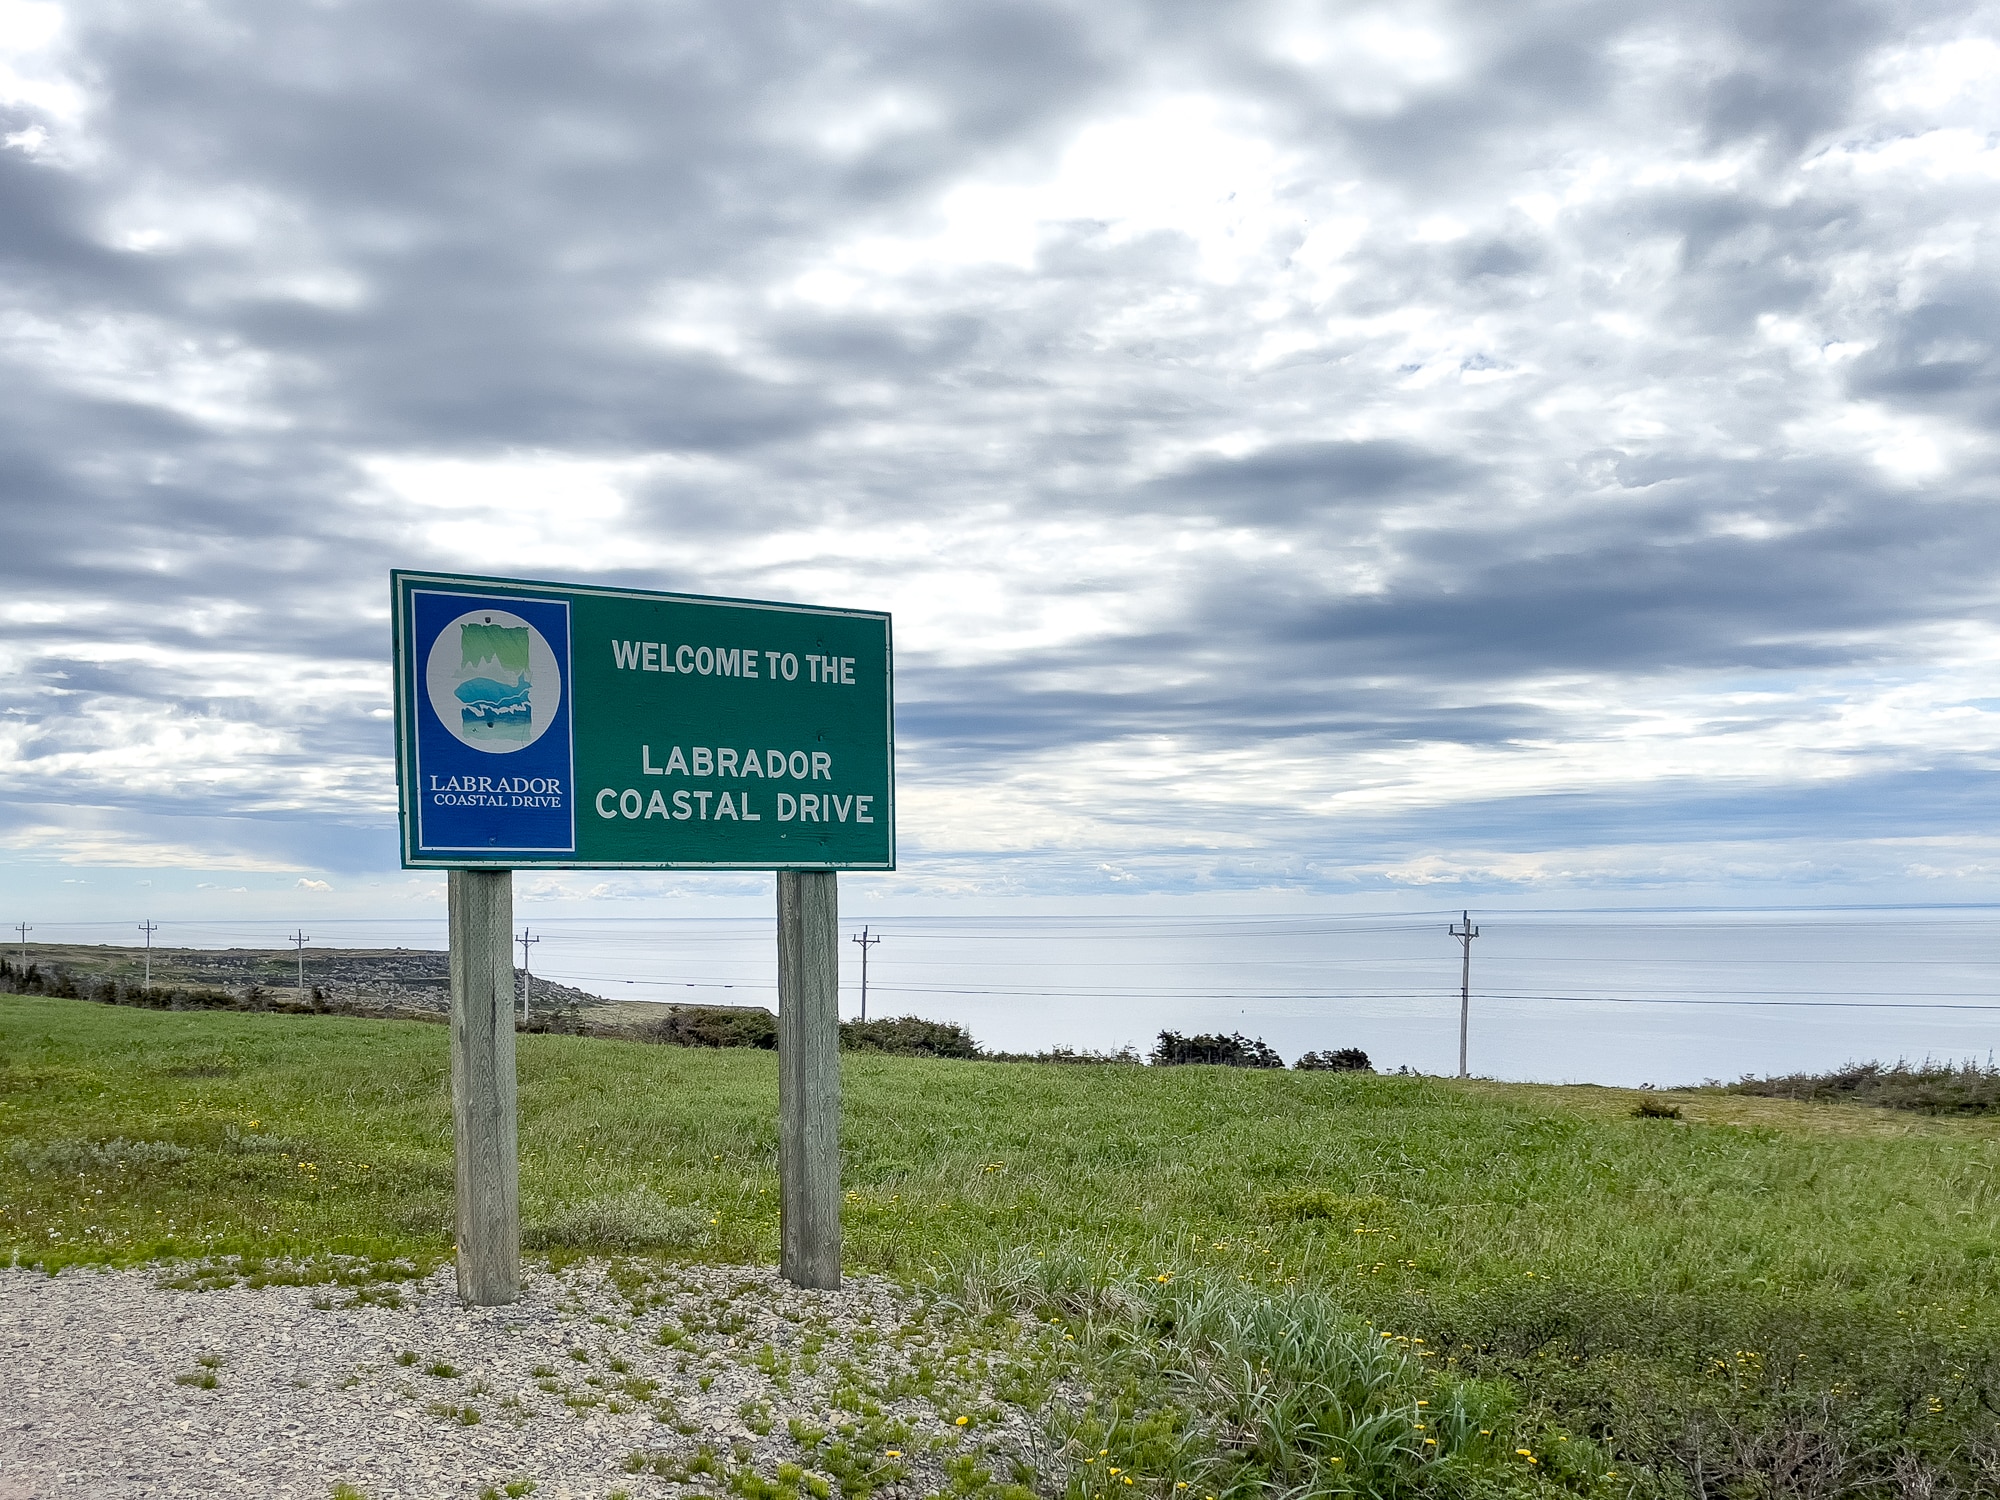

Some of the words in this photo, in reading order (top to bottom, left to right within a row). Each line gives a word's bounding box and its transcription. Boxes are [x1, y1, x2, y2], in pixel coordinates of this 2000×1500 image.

[611, 639, 759, 679] WELCOME
[764, 651, 799, 682] TO
[805, 654, 856, 685] THE
[643, 745, 832, 780] LABRADOR
[430, 775, 563, 795] LABRADOR
[434, 794, 508, 807] COASTAL
[511, 796, 561, 808] DRIVE
[595, 788, 761, 821] COASTAL
[777, 793, 874, 824] DRIVE
